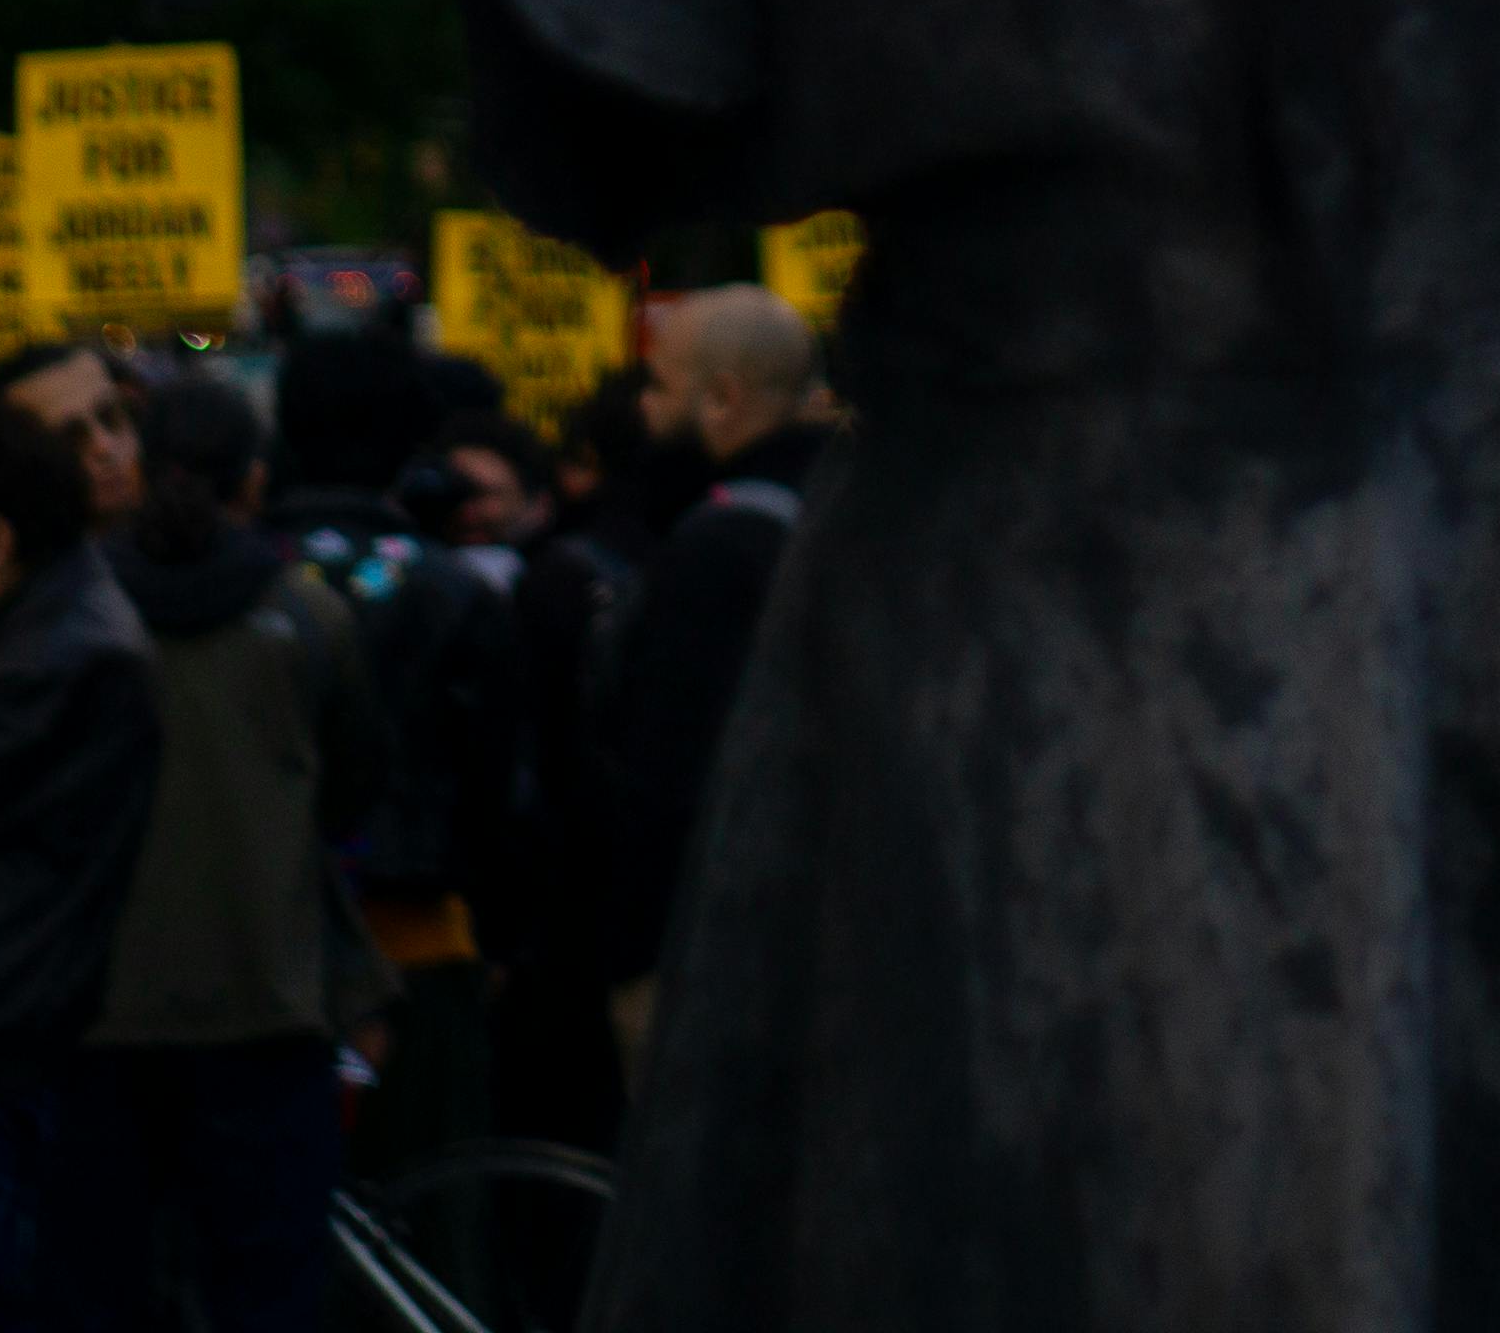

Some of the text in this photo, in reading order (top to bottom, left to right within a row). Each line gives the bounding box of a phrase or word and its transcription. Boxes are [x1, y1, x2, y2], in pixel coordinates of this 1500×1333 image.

[37, 68, 216, 124] JUSTICE
[82, 131, 174, 182] FOR
[52, 200, 212, 246] JORDAN
[68, 250, 196, 293] NEELY
